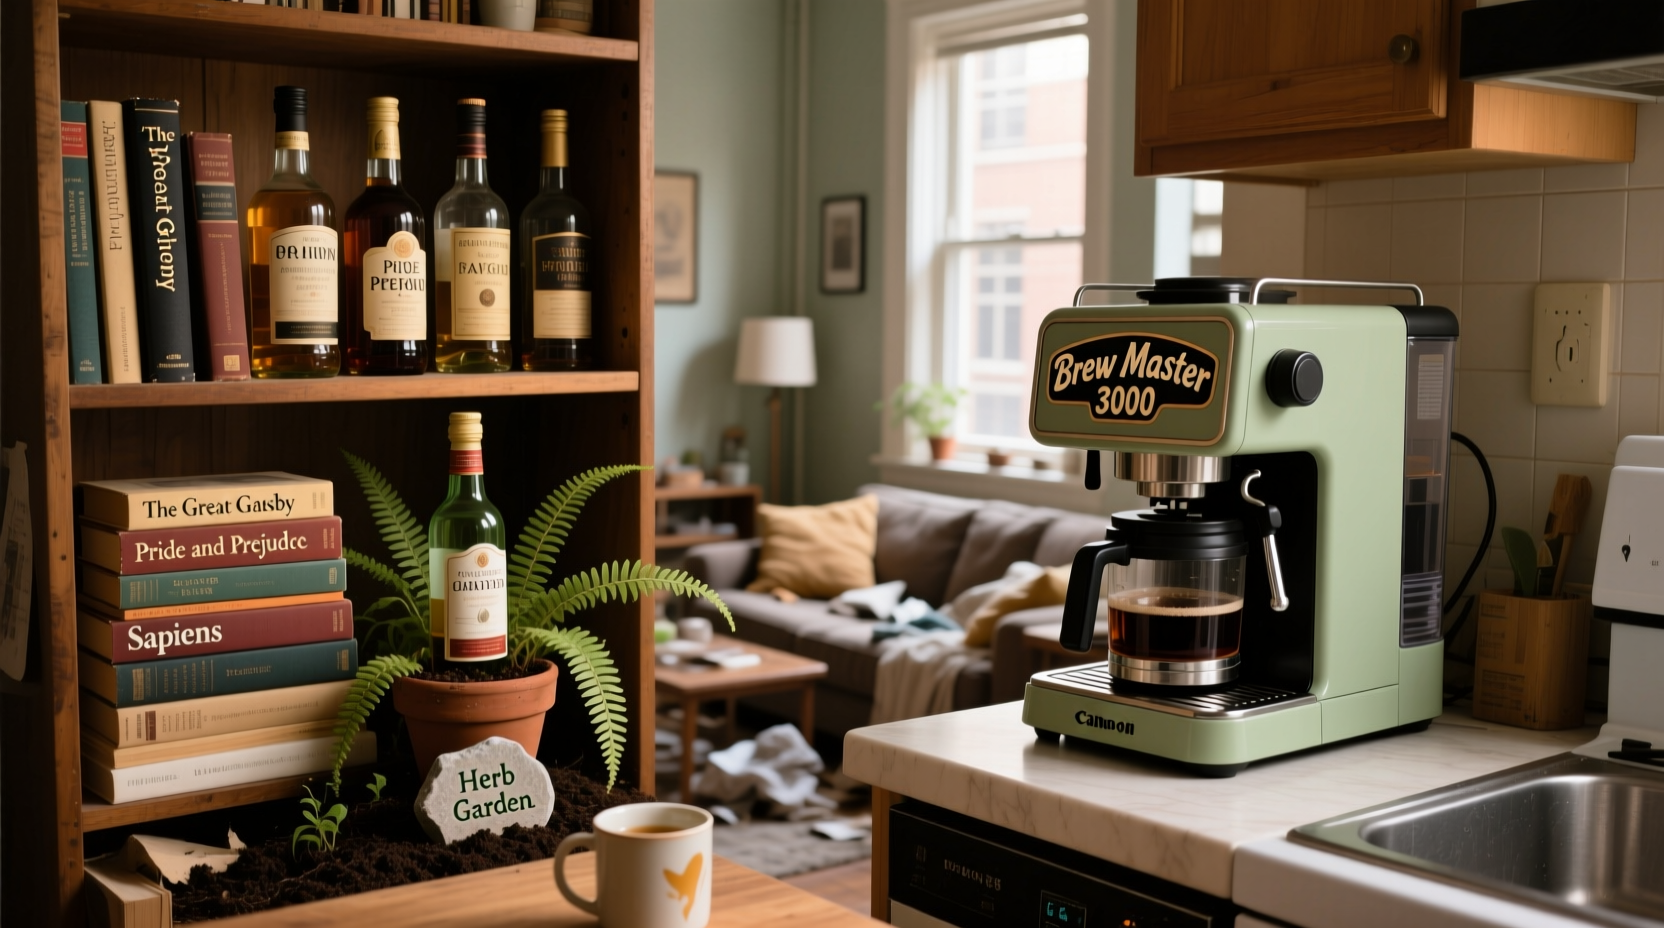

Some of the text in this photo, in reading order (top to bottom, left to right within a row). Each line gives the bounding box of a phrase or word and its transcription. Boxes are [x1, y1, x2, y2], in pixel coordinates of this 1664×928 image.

[1053, 341, 1211, 393] Brew Master
[1095, 385, 1156, 416] 3000
[142, 499, 177, 519] The
[182, 497, 232, 517] Great
[134, 539, 186, 563] Pride
[191, 535, 225, 558] and
[128, 622, 223, 656] Sapiens
[458, 762, 515, 793] Herb
[453, 791, 536, 821] Garden
